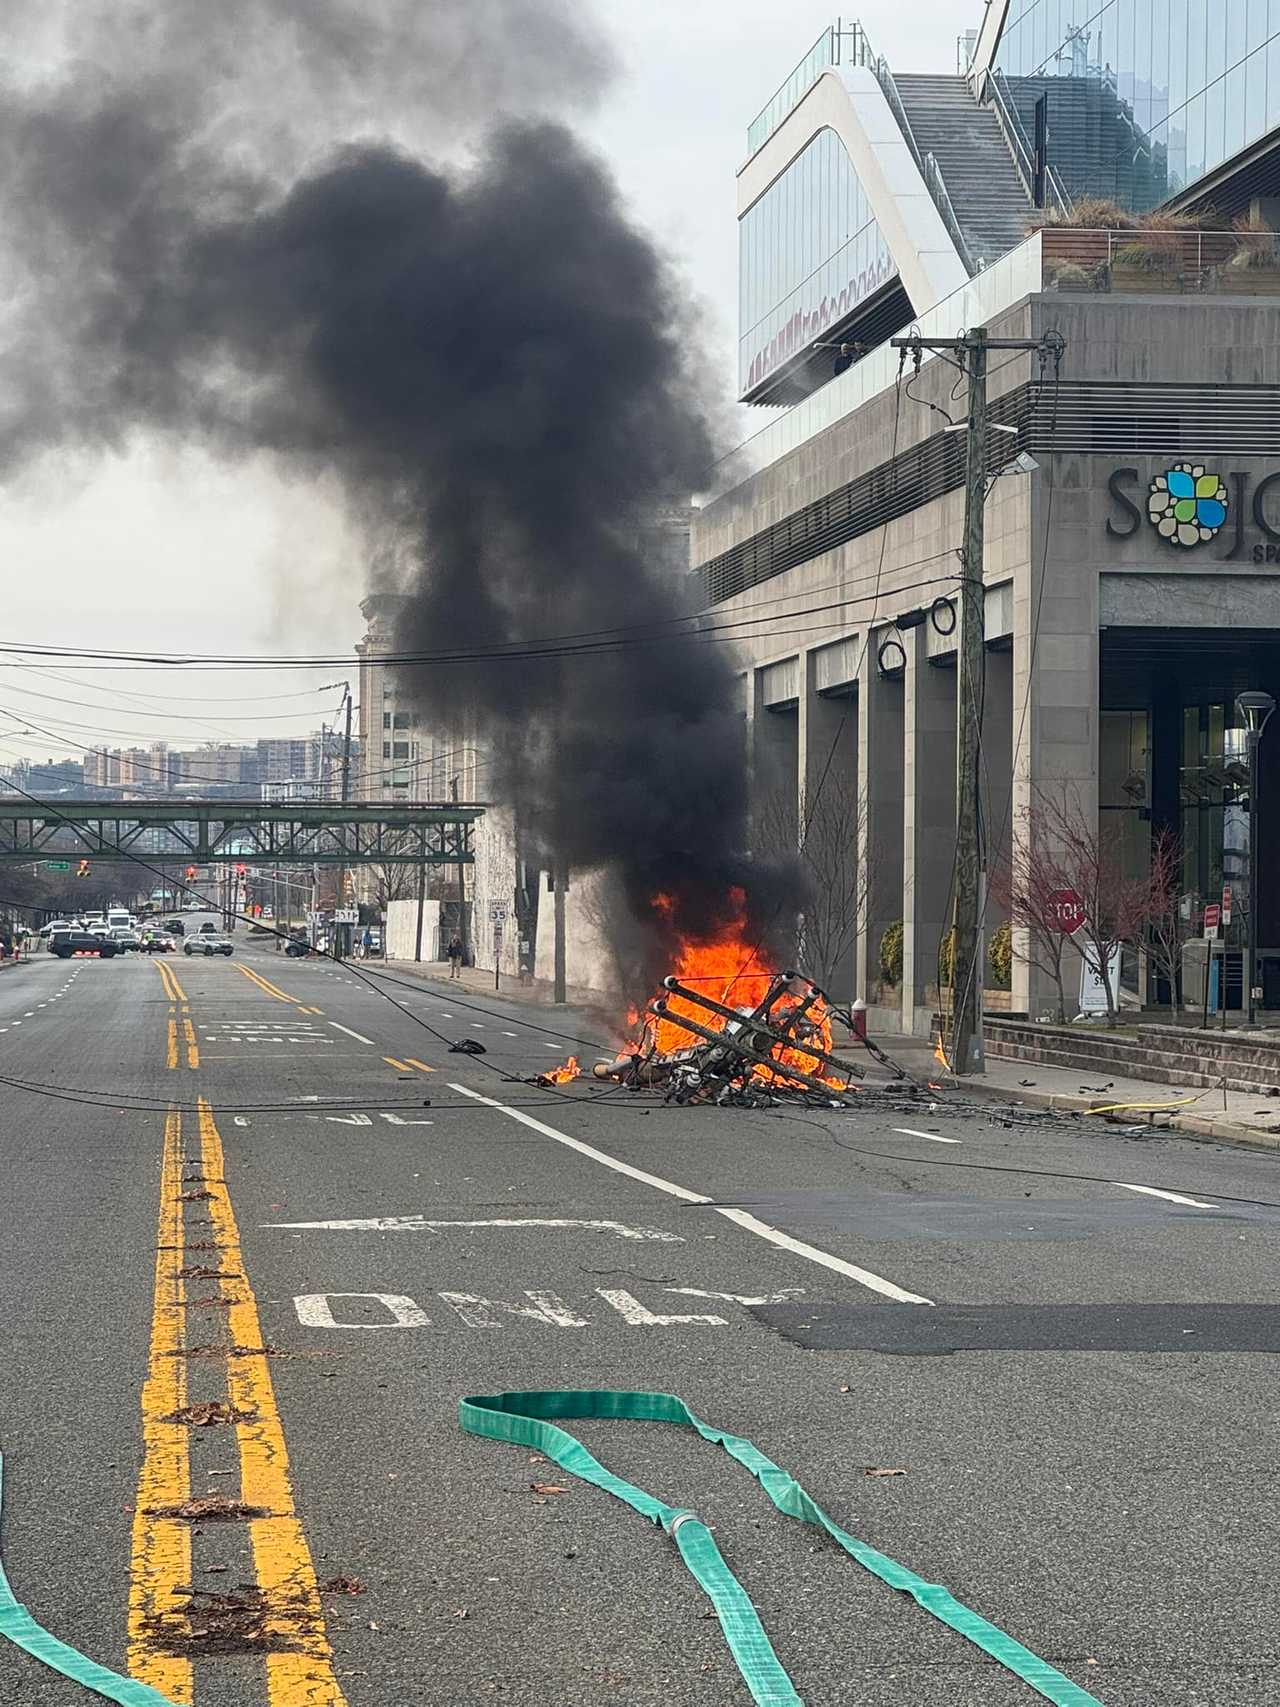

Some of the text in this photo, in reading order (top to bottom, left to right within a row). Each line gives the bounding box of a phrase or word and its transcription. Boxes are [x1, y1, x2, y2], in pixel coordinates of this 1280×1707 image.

[491, 911, 506, 920] 35
[1044, 903, 1084, 920] STOP
[1088, 966, 1116, 975] VAT
[292, 1286, 805, 1329] ONLY
